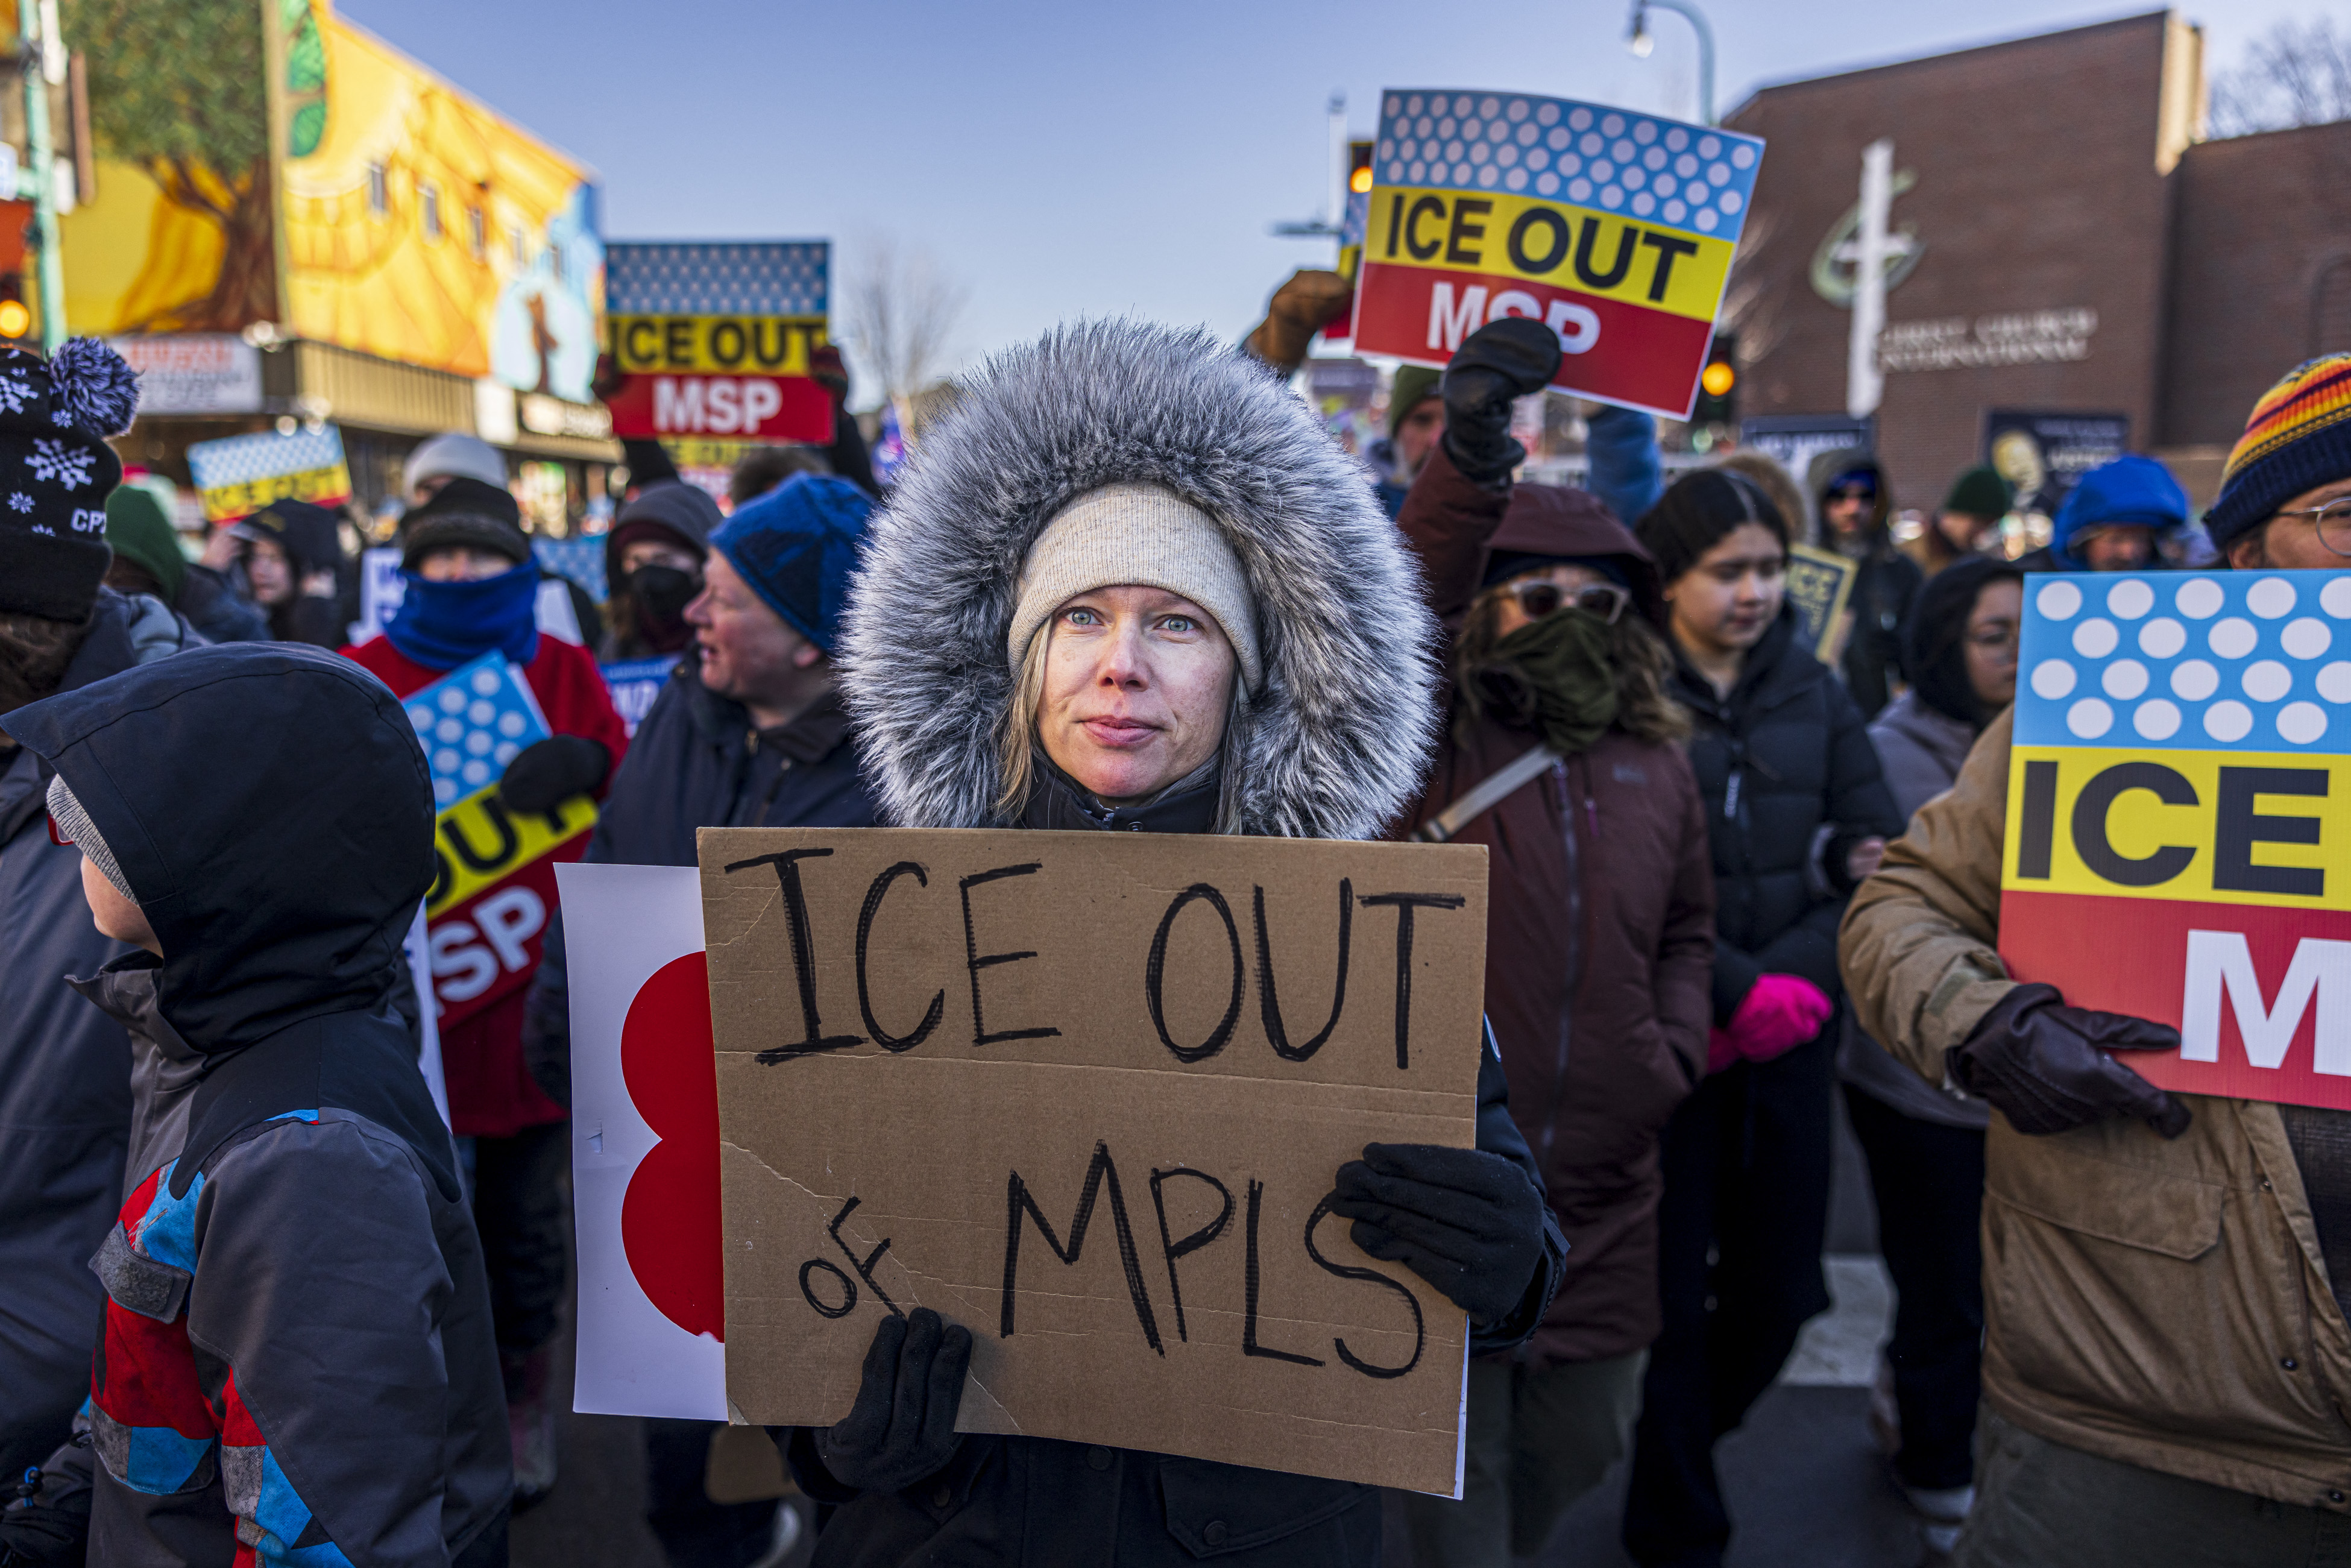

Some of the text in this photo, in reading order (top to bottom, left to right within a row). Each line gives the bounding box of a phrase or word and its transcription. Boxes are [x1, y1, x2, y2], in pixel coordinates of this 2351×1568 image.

[1386, 194, 1494, 264] ICE
[1507, 207, 1699, 303] OUT
[609, 320, 823, 366] ICE OUT
[653, 377, 782, 434] MSP
[2017, 761, 2329, 896] ICE
[429, 885, 546, 1013] SP
[724, 848, 1465, 1070] ICE OUT
[1000, 1139, 1426, 1379] MPLS
